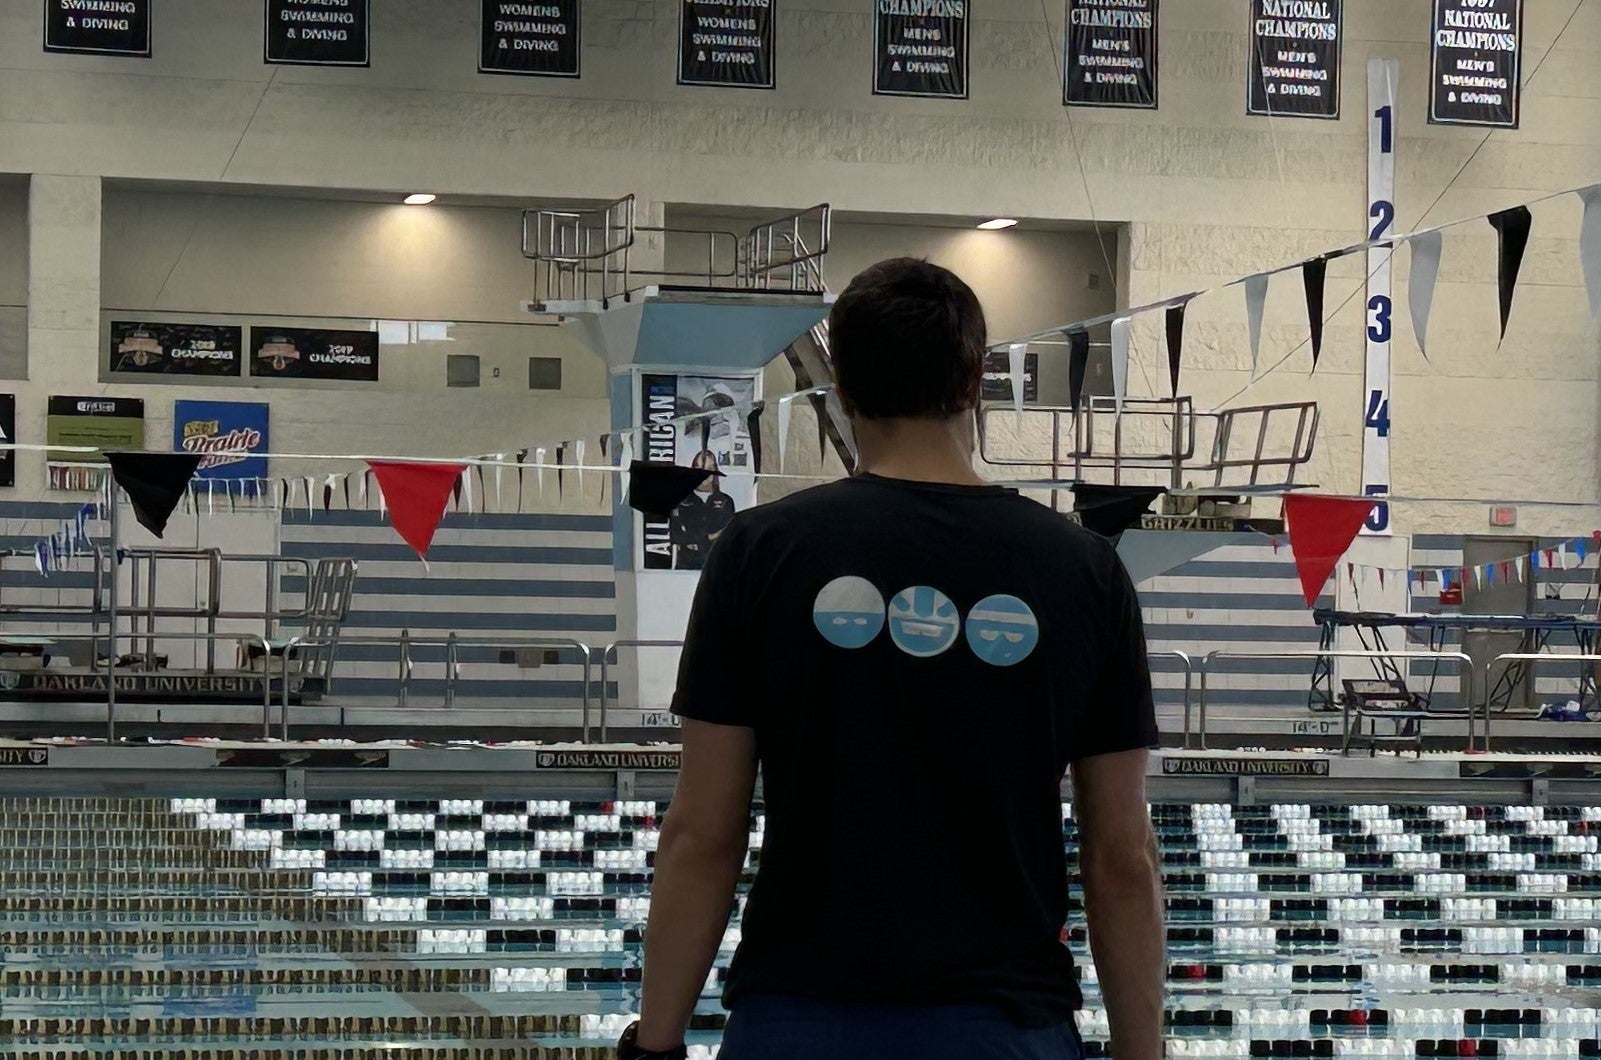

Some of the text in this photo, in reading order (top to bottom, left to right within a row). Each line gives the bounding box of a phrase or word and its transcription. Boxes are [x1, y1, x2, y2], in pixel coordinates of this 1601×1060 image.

[880, 0, 964, 18] CHAMPIONS
[1071, 8, 1152, 28] CHAMPIONS
[1262, 0, 1331, 19] NATIONAL
[82, 17, 129, 30] DIVING
[1255, 19, 1336, 40] CHAMPIONS
[1444, 10, 1511, 30] NATIONAL
[301, 28, 348, 41] DIVING
[1436, 29, 1516, 52] CHAMPIONS
[513, 39, 559, 52] DIVING
[712, 51, 755, 65] DIVING
[906, 61, 949, 73] DIVING
[1096, 72, 1137, 85] DIVING
[1280, 83, 1321, 97] DIVING
[1460, 92, 1502, 105] DIVING
[1374, 105, 1392, 153] 1
[1370, 200, 1395, 249] 2
[1367, 294, 1392, 343] 3
[1365, 389, 1390, 437] 4
[649, 394, 676, 463] RICAN
[182, 426, 262, 453] Prairie
[1365, 484, 1389, 531] 5
[645, 520, 672, 556] ALL
[33, 675, 269, 692] OAKLAND UNIVERSITY
[557, 752, 681, 768] OAKLAND UNIVERSI
[1181, 759, 1310, 775] OAKLAND UNIVERSITY
